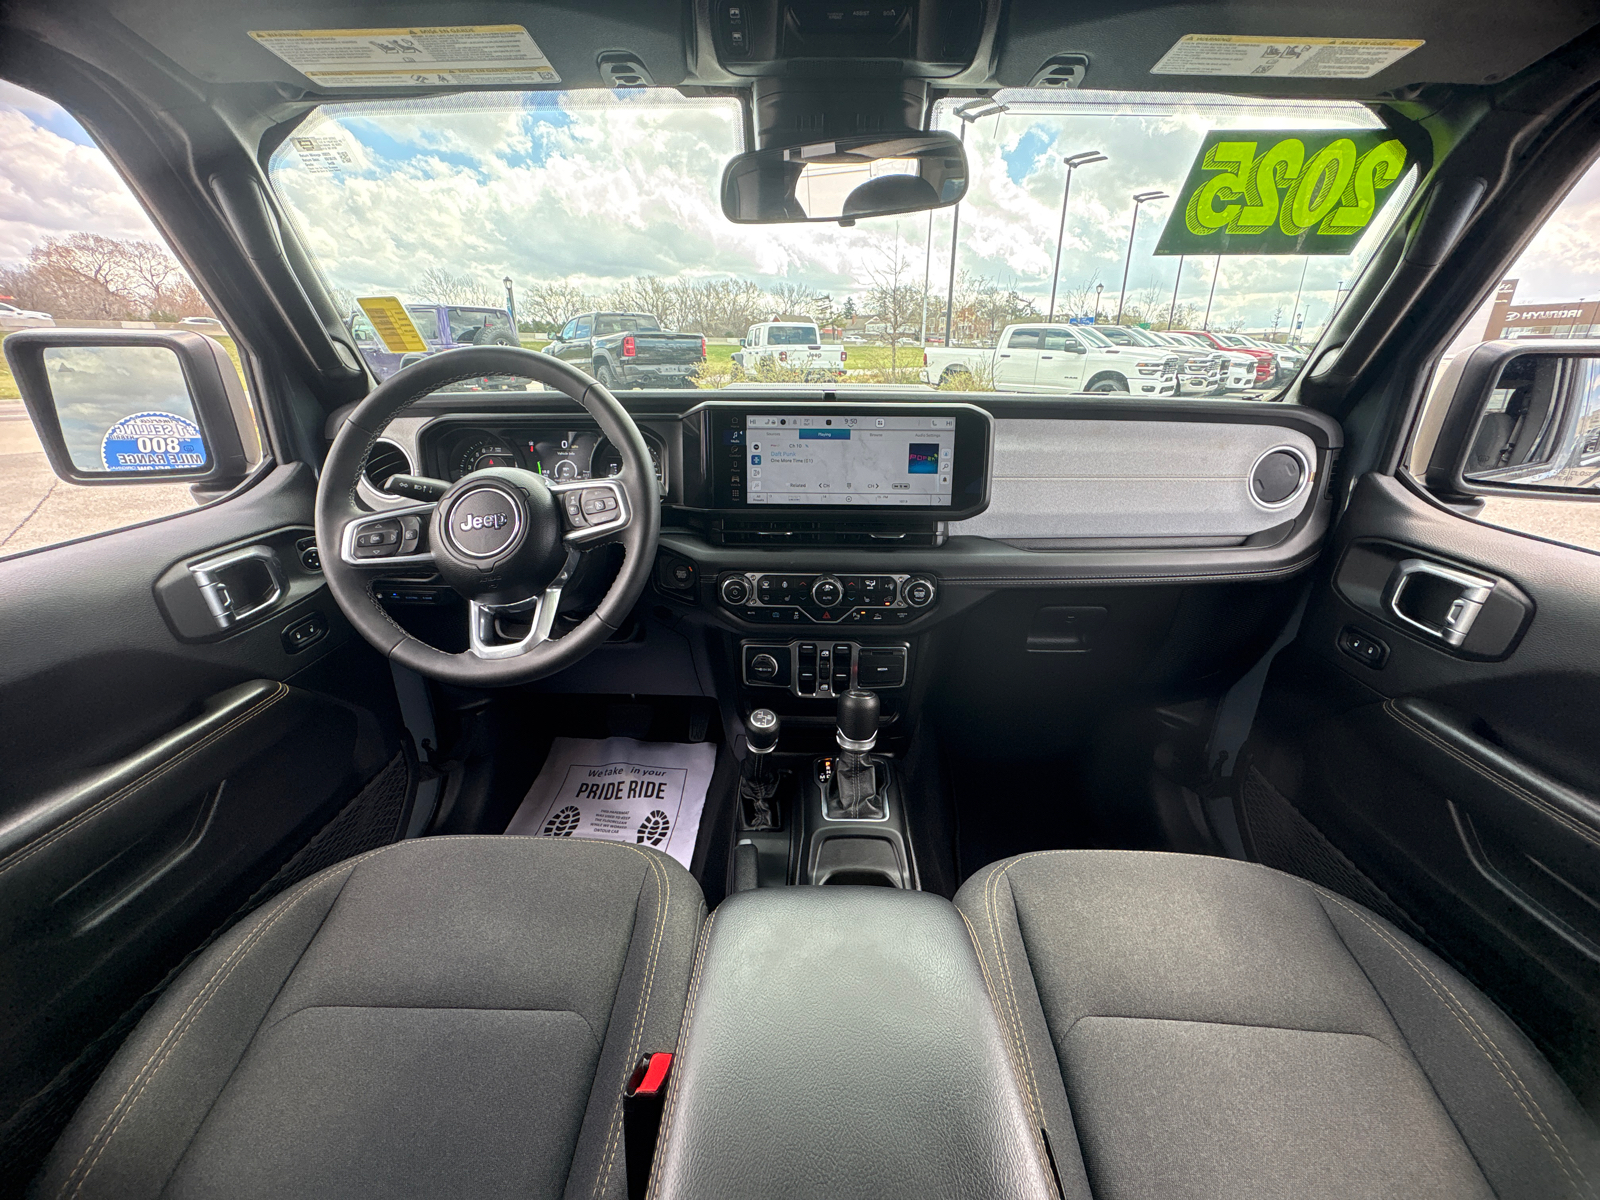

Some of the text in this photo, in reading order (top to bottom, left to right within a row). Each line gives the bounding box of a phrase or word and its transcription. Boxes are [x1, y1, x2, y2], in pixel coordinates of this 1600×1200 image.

[1521, 309, 1583, 320] HYUNDAI
[561, 440, 568, 449] 0
[460, 512, 508, 531] Jeep
[588, 766, 667, 778] We take in your
[575, 780, 668, 800] PRIDE RIDE
